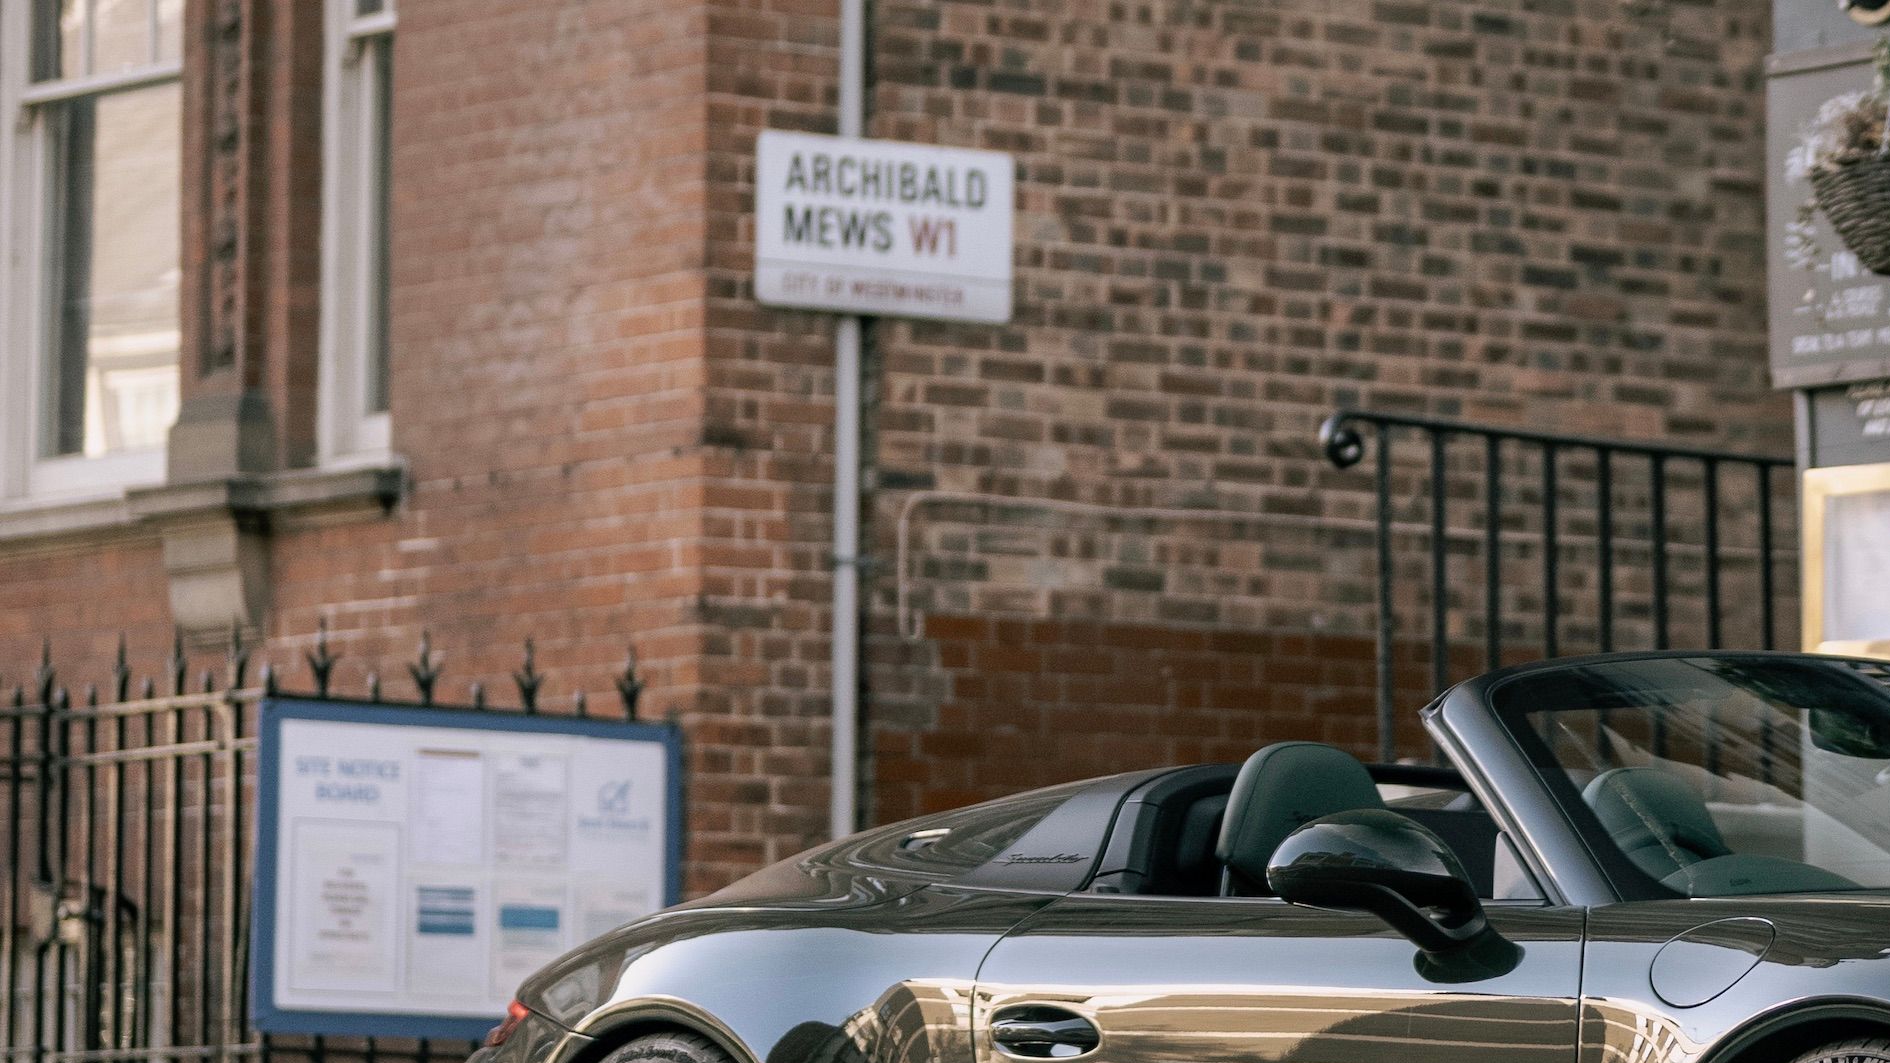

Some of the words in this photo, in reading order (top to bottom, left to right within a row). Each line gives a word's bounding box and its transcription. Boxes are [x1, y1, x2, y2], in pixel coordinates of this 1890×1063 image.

[785, 152, 988, 208] ARCHIBALD
[783, 203, 895, 253] MEWS
[909, 214, 958, 259] W1
[296, 756, 331, 777] SITE
[337, 758, 400, 781] NOTICE
[315, 782, 381, 803] BOARD
